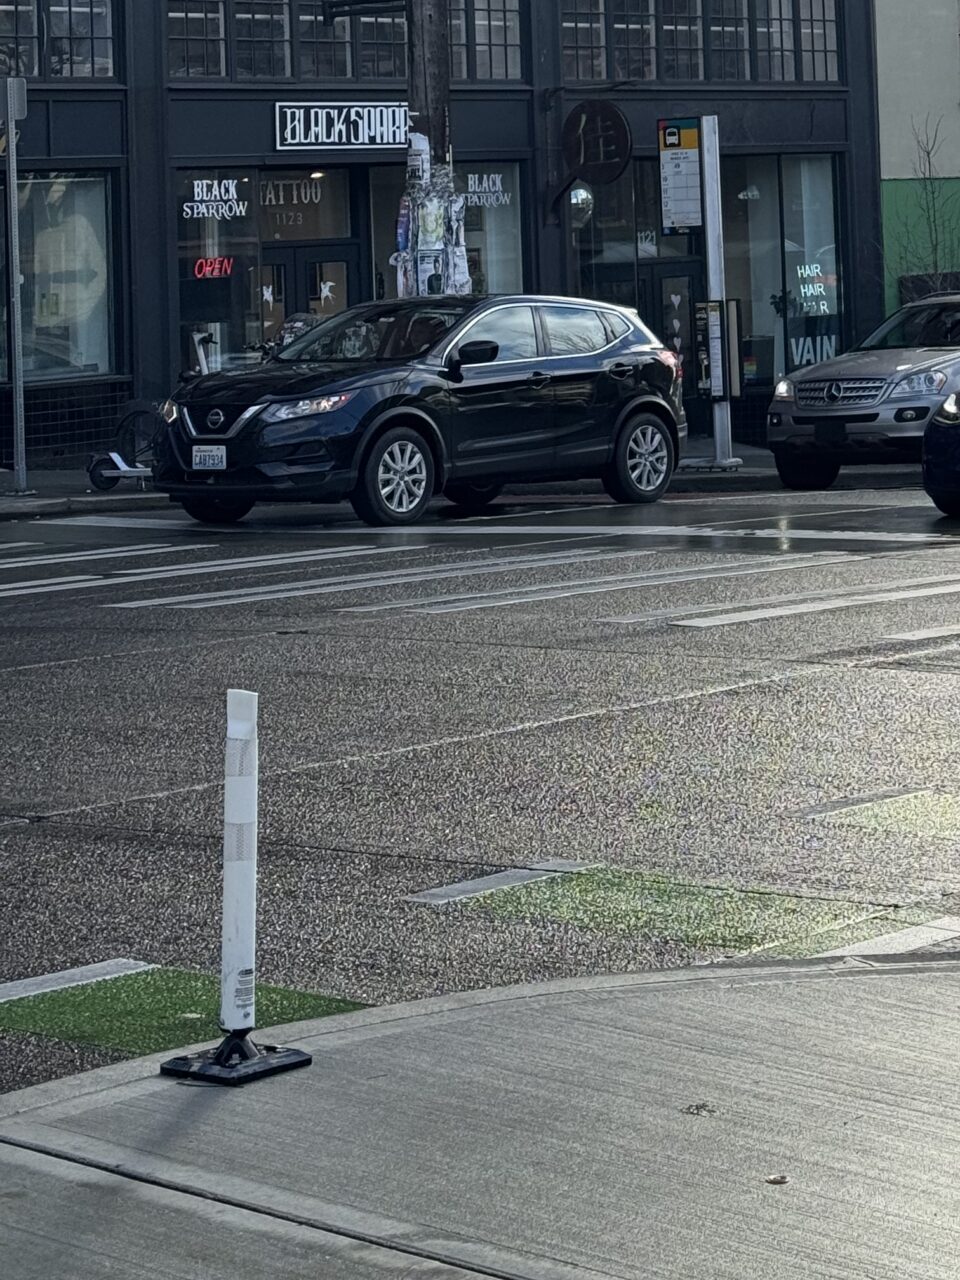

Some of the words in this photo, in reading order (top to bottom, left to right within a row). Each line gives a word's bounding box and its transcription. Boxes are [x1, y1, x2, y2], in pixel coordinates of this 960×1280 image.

[282, 107, 349, 144] BLACK
[350, 107, 408, 144] SPARR
[193, 179, 238, 201] BLACK
[467, 173, 503, 192] BLACK
[461, 191, 512, 208] PARROW
[182, 200, 248, 220] SPARROW
[276, 213, 303, 225] 1123
[194, 257, 234, 279] OPEN
[797, 263, 823, 279] HAIR
[800, 283, 826, 298] HAIR
[790, 334, 836, 366] VAIN
